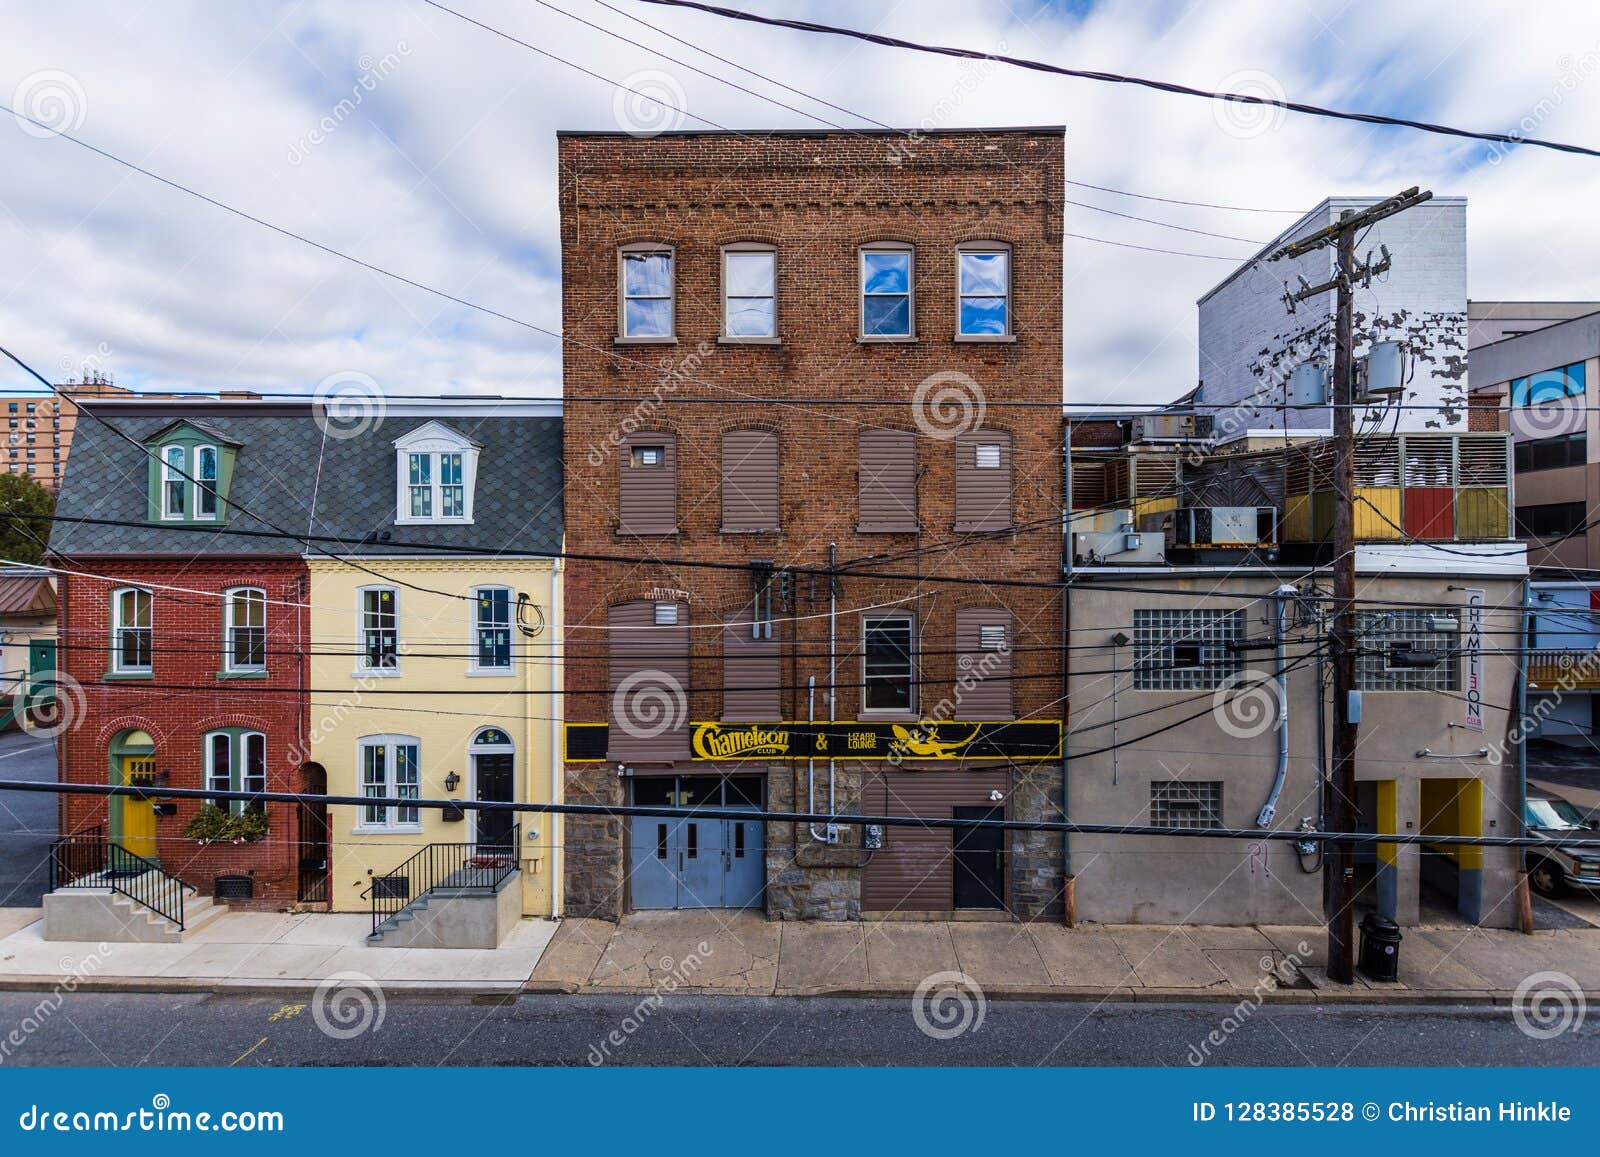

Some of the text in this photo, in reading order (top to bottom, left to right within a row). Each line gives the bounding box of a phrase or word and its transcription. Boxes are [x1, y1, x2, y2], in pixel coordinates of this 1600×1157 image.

[692, 722, 789, 760] Chameleon
[815, 732, 829, 751] &
[847, 732, 877, 742] LIZARD
[847, 739, 878, 750] LOUNGE
[757, 746, 777, 755] CLUB
